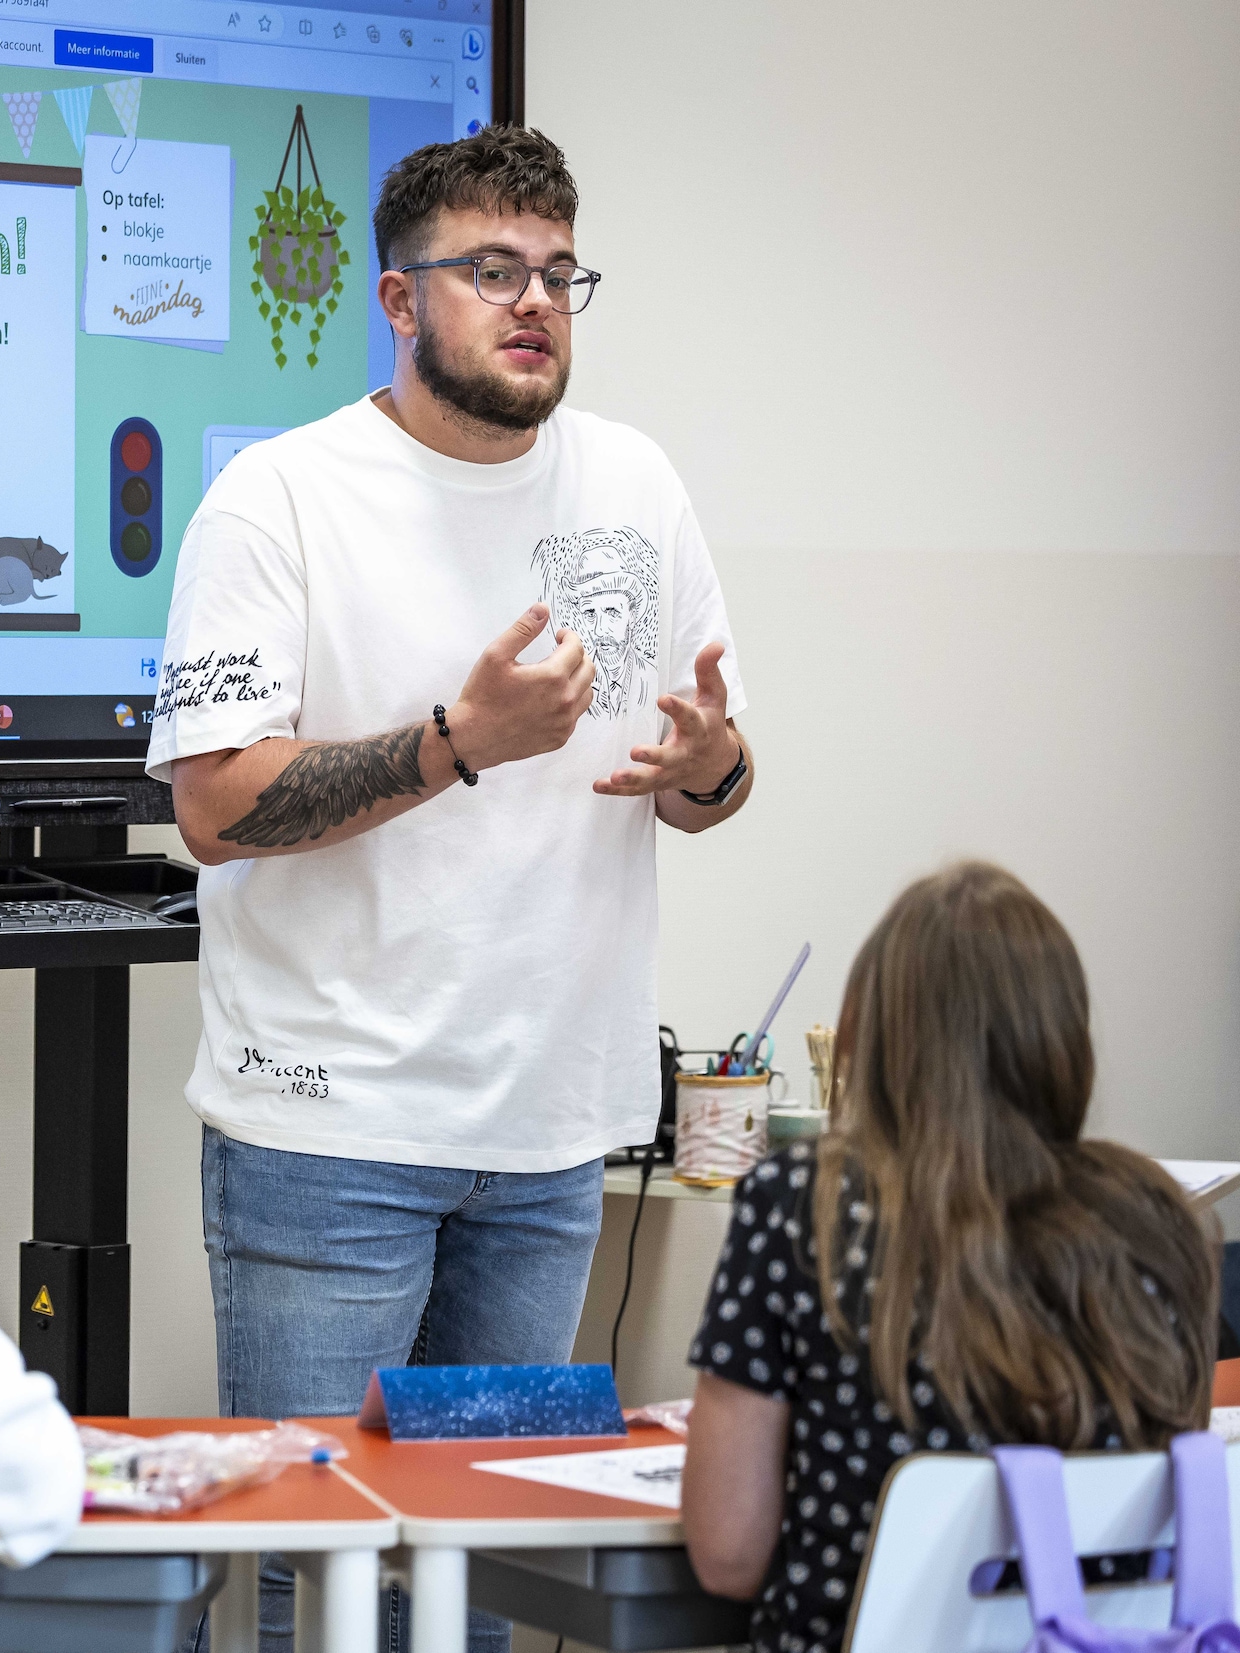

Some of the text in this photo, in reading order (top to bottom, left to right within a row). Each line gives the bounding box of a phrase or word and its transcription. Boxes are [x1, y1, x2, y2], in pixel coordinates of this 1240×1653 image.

[67, 42, 141, 61] Meer informatie
[175, 52, 206, 66] Sluiten
[102, 190, 165, 210] Op tafel:
[123, 220, 165, 243] blokje
[123, 252, 212, 275] naamkaartje
[113, 278, 205, 326] maandag
[136, 279, 164, 307] FIJNE
[217, 647, 263, 669] work
[200, 668, 221, 695] if
[223, 671, 255, 687] one
[211, 683, 229, 704] to
